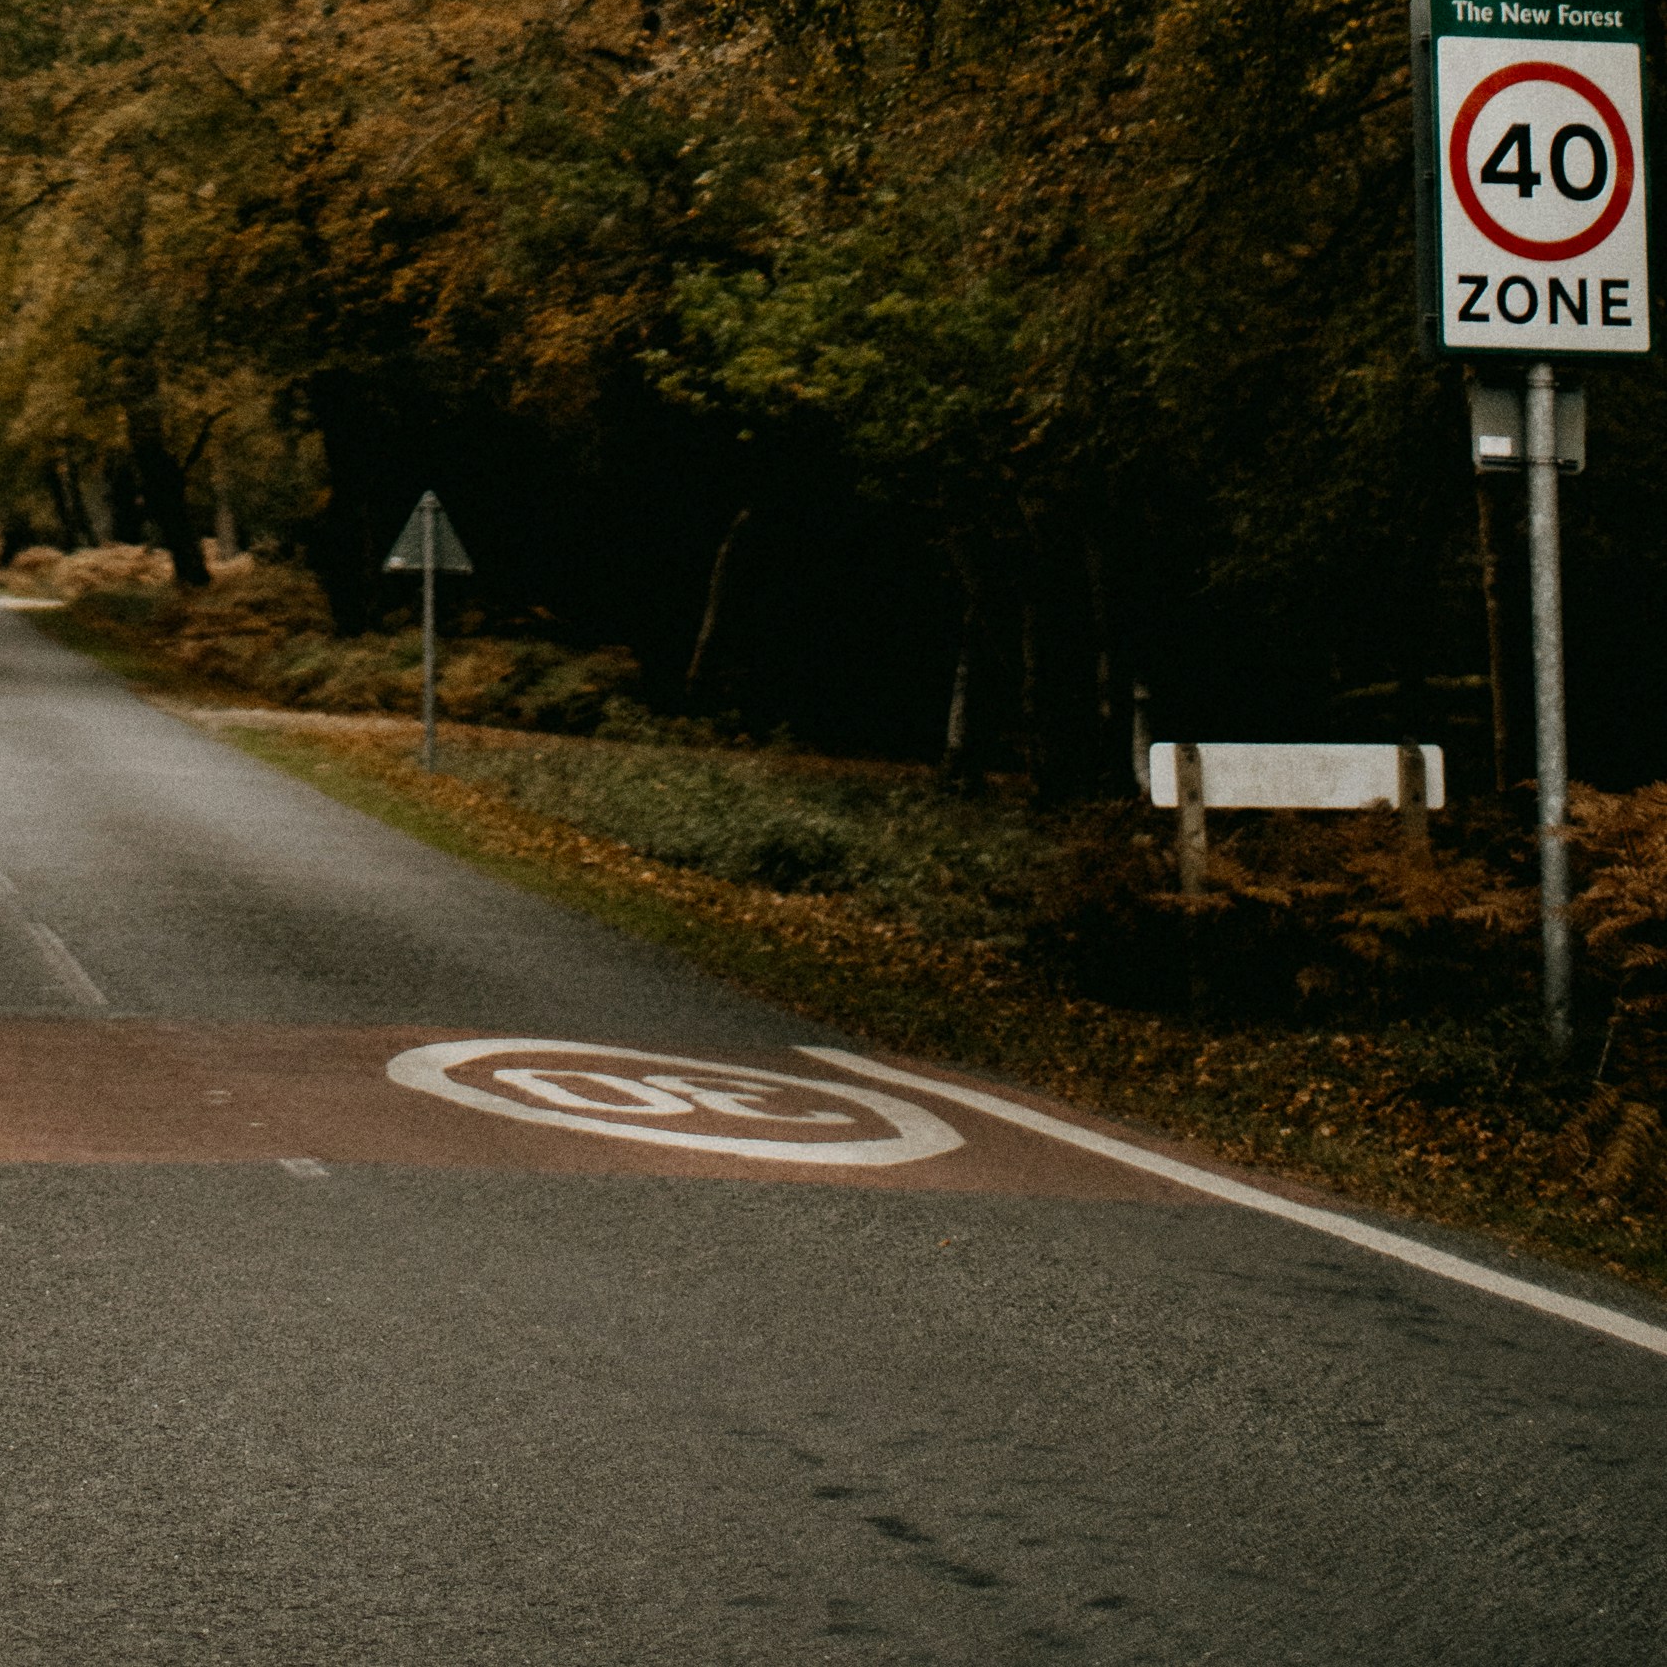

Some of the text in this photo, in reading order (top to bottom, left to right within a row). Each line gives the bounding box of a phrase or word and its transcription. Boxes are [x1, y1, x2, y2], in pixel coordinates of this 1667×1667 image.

[1452, 0, 1623, 28] The New Forest
[1481, 123, 1608, 201] 40
[1458, 275, 1632, 327] ZONE
